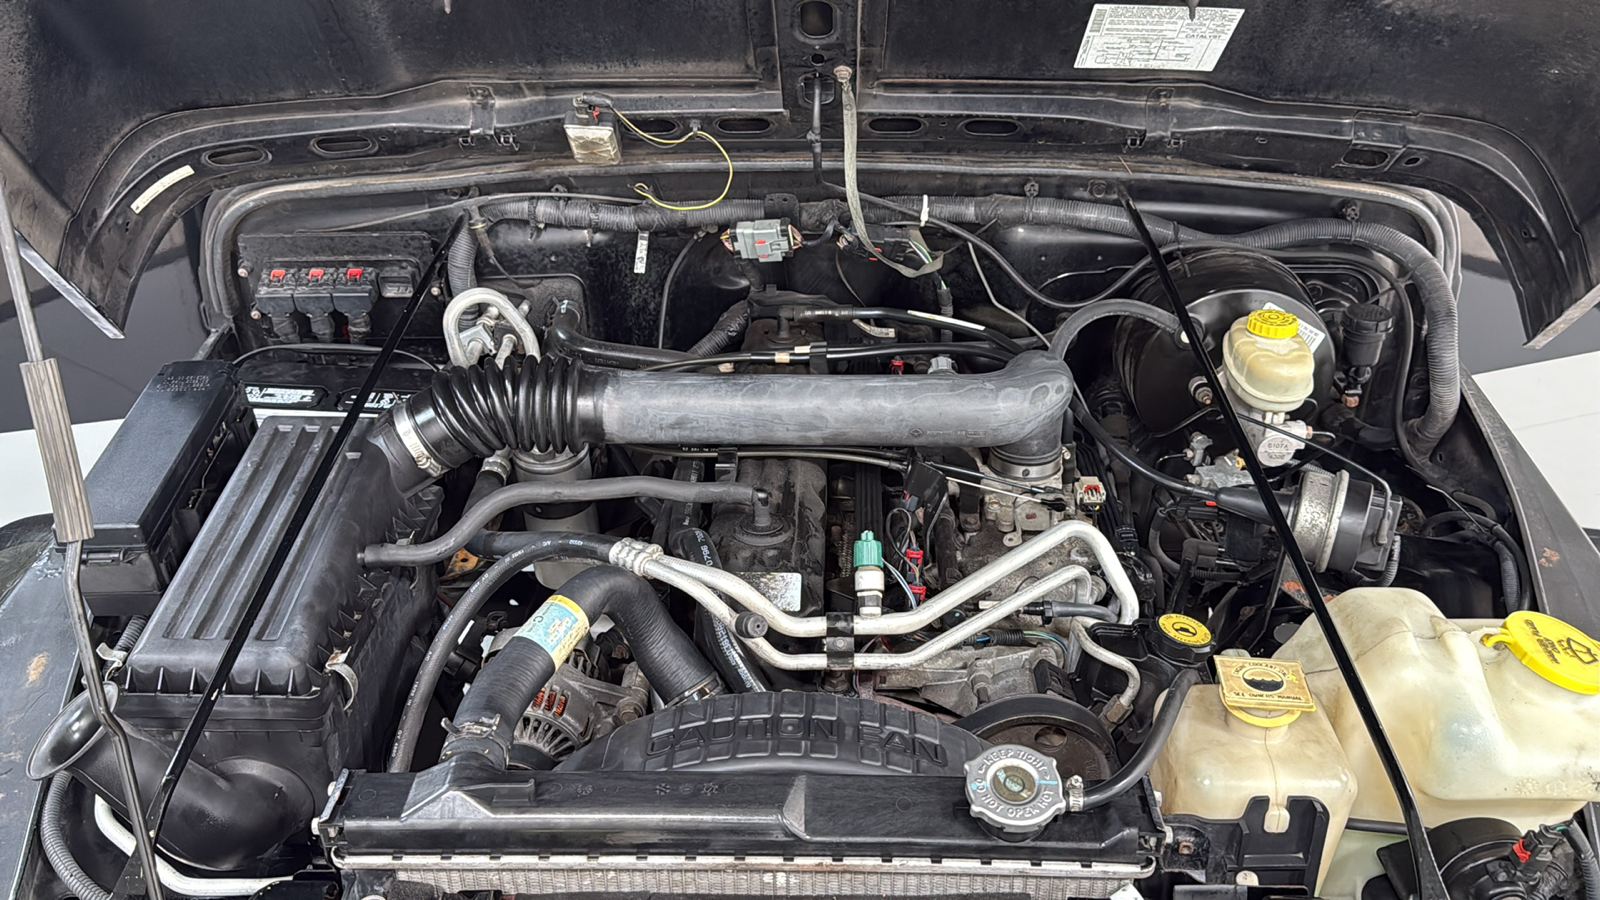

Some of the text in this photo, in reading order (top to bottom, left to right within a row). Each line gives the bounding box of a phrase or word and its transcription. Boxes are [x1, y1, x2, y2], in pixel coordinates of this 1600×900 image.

[1248, 662, 1278, 671] COOLANT
[646, 717, 946, 766] CAUTION FAN
[983, 749, 1048, 771] KEEP TIGHT
[981, 793, 1005, 813] NOT
[1006, 807, 1040, 819] OPEN
[1037, 790, 1054, 809] HOT
